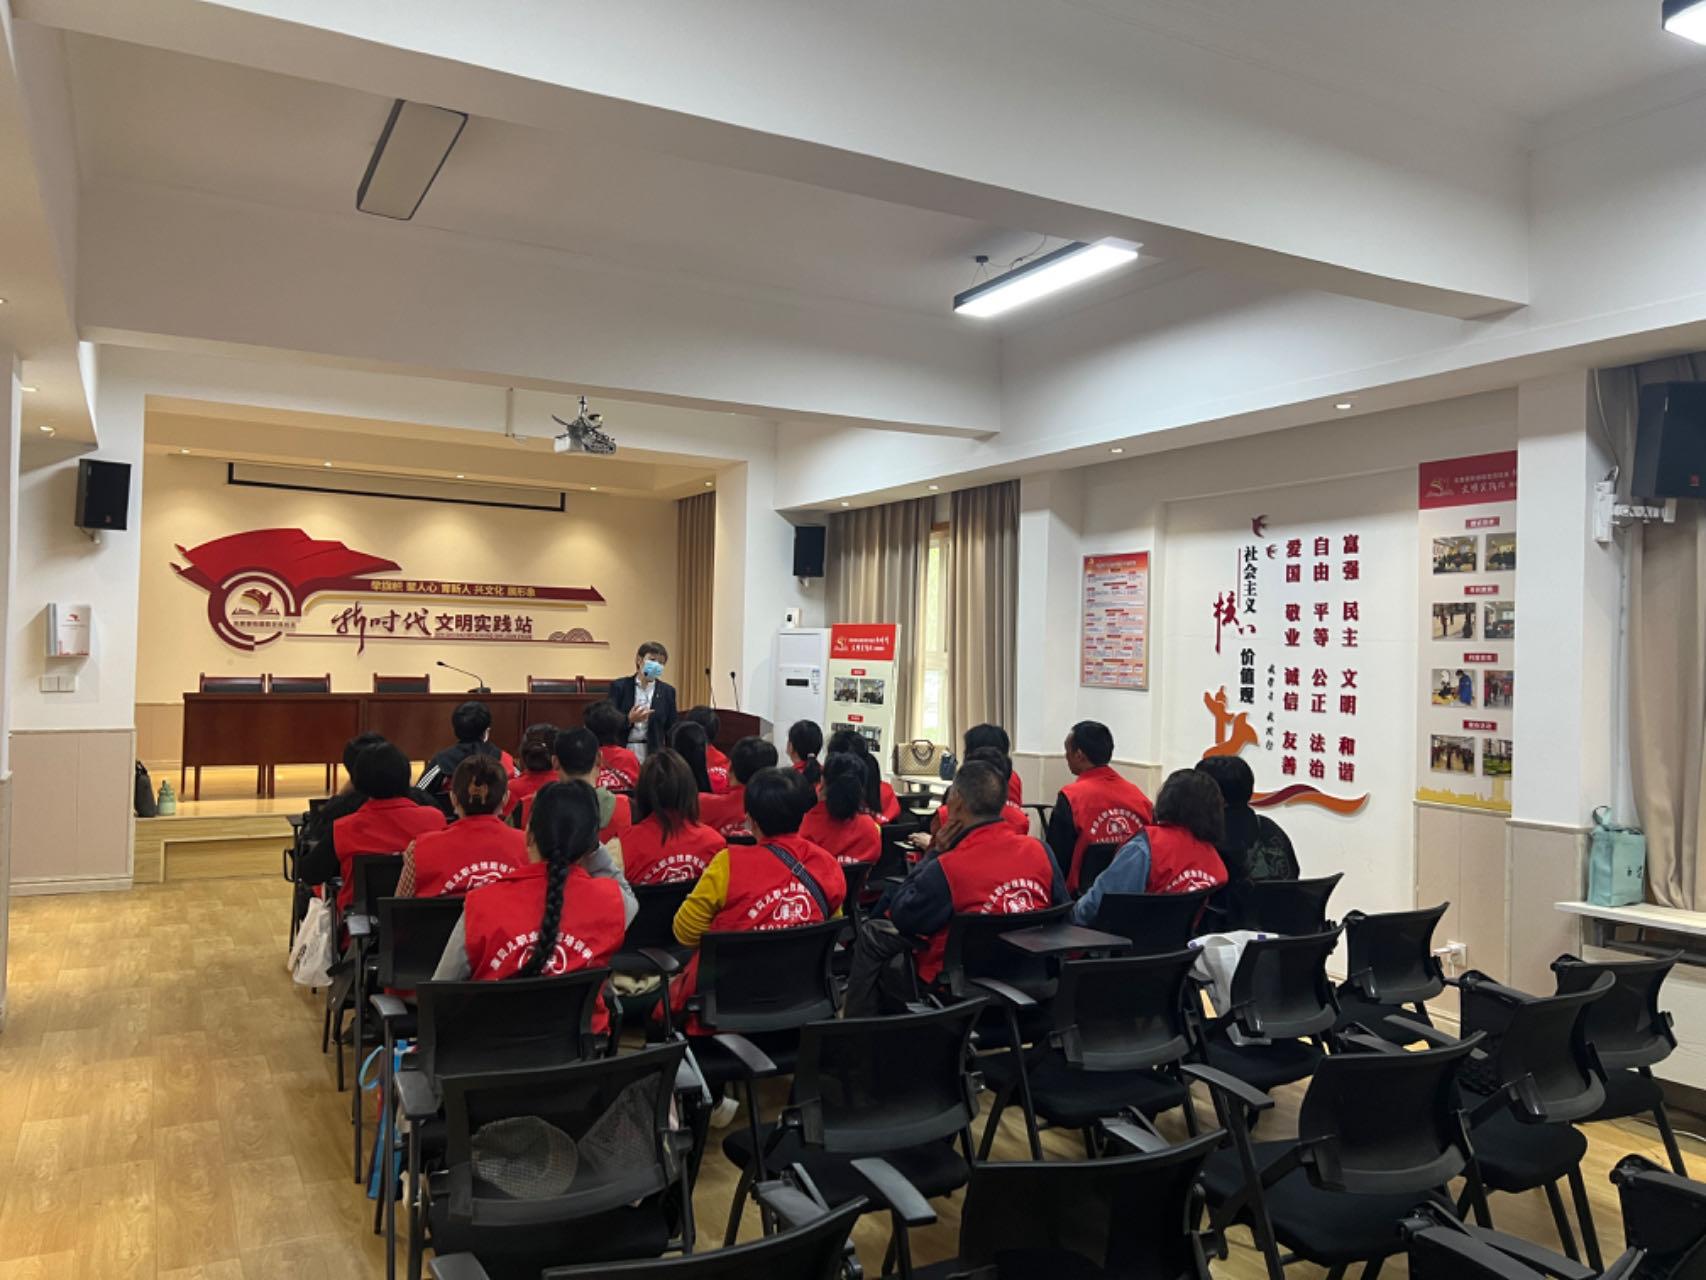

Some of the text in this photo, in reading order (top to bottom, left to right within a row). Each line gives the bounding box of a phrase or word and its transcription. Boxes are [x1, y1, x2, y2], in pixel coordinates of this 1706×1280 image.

[435, 613, 534, 634] 文明实践站
[1243, 545, 1258, 614] 社会主义
[1240, 648, 1256, 705] 价值观
[1281, 538, 1302, 776] 爱国 敬业 诚信 友善
[1309, 536, 1330, 780] 自由 平等 公正 法治
[1338, 534, 1360, 783] 富强 民主 文明 和谐
